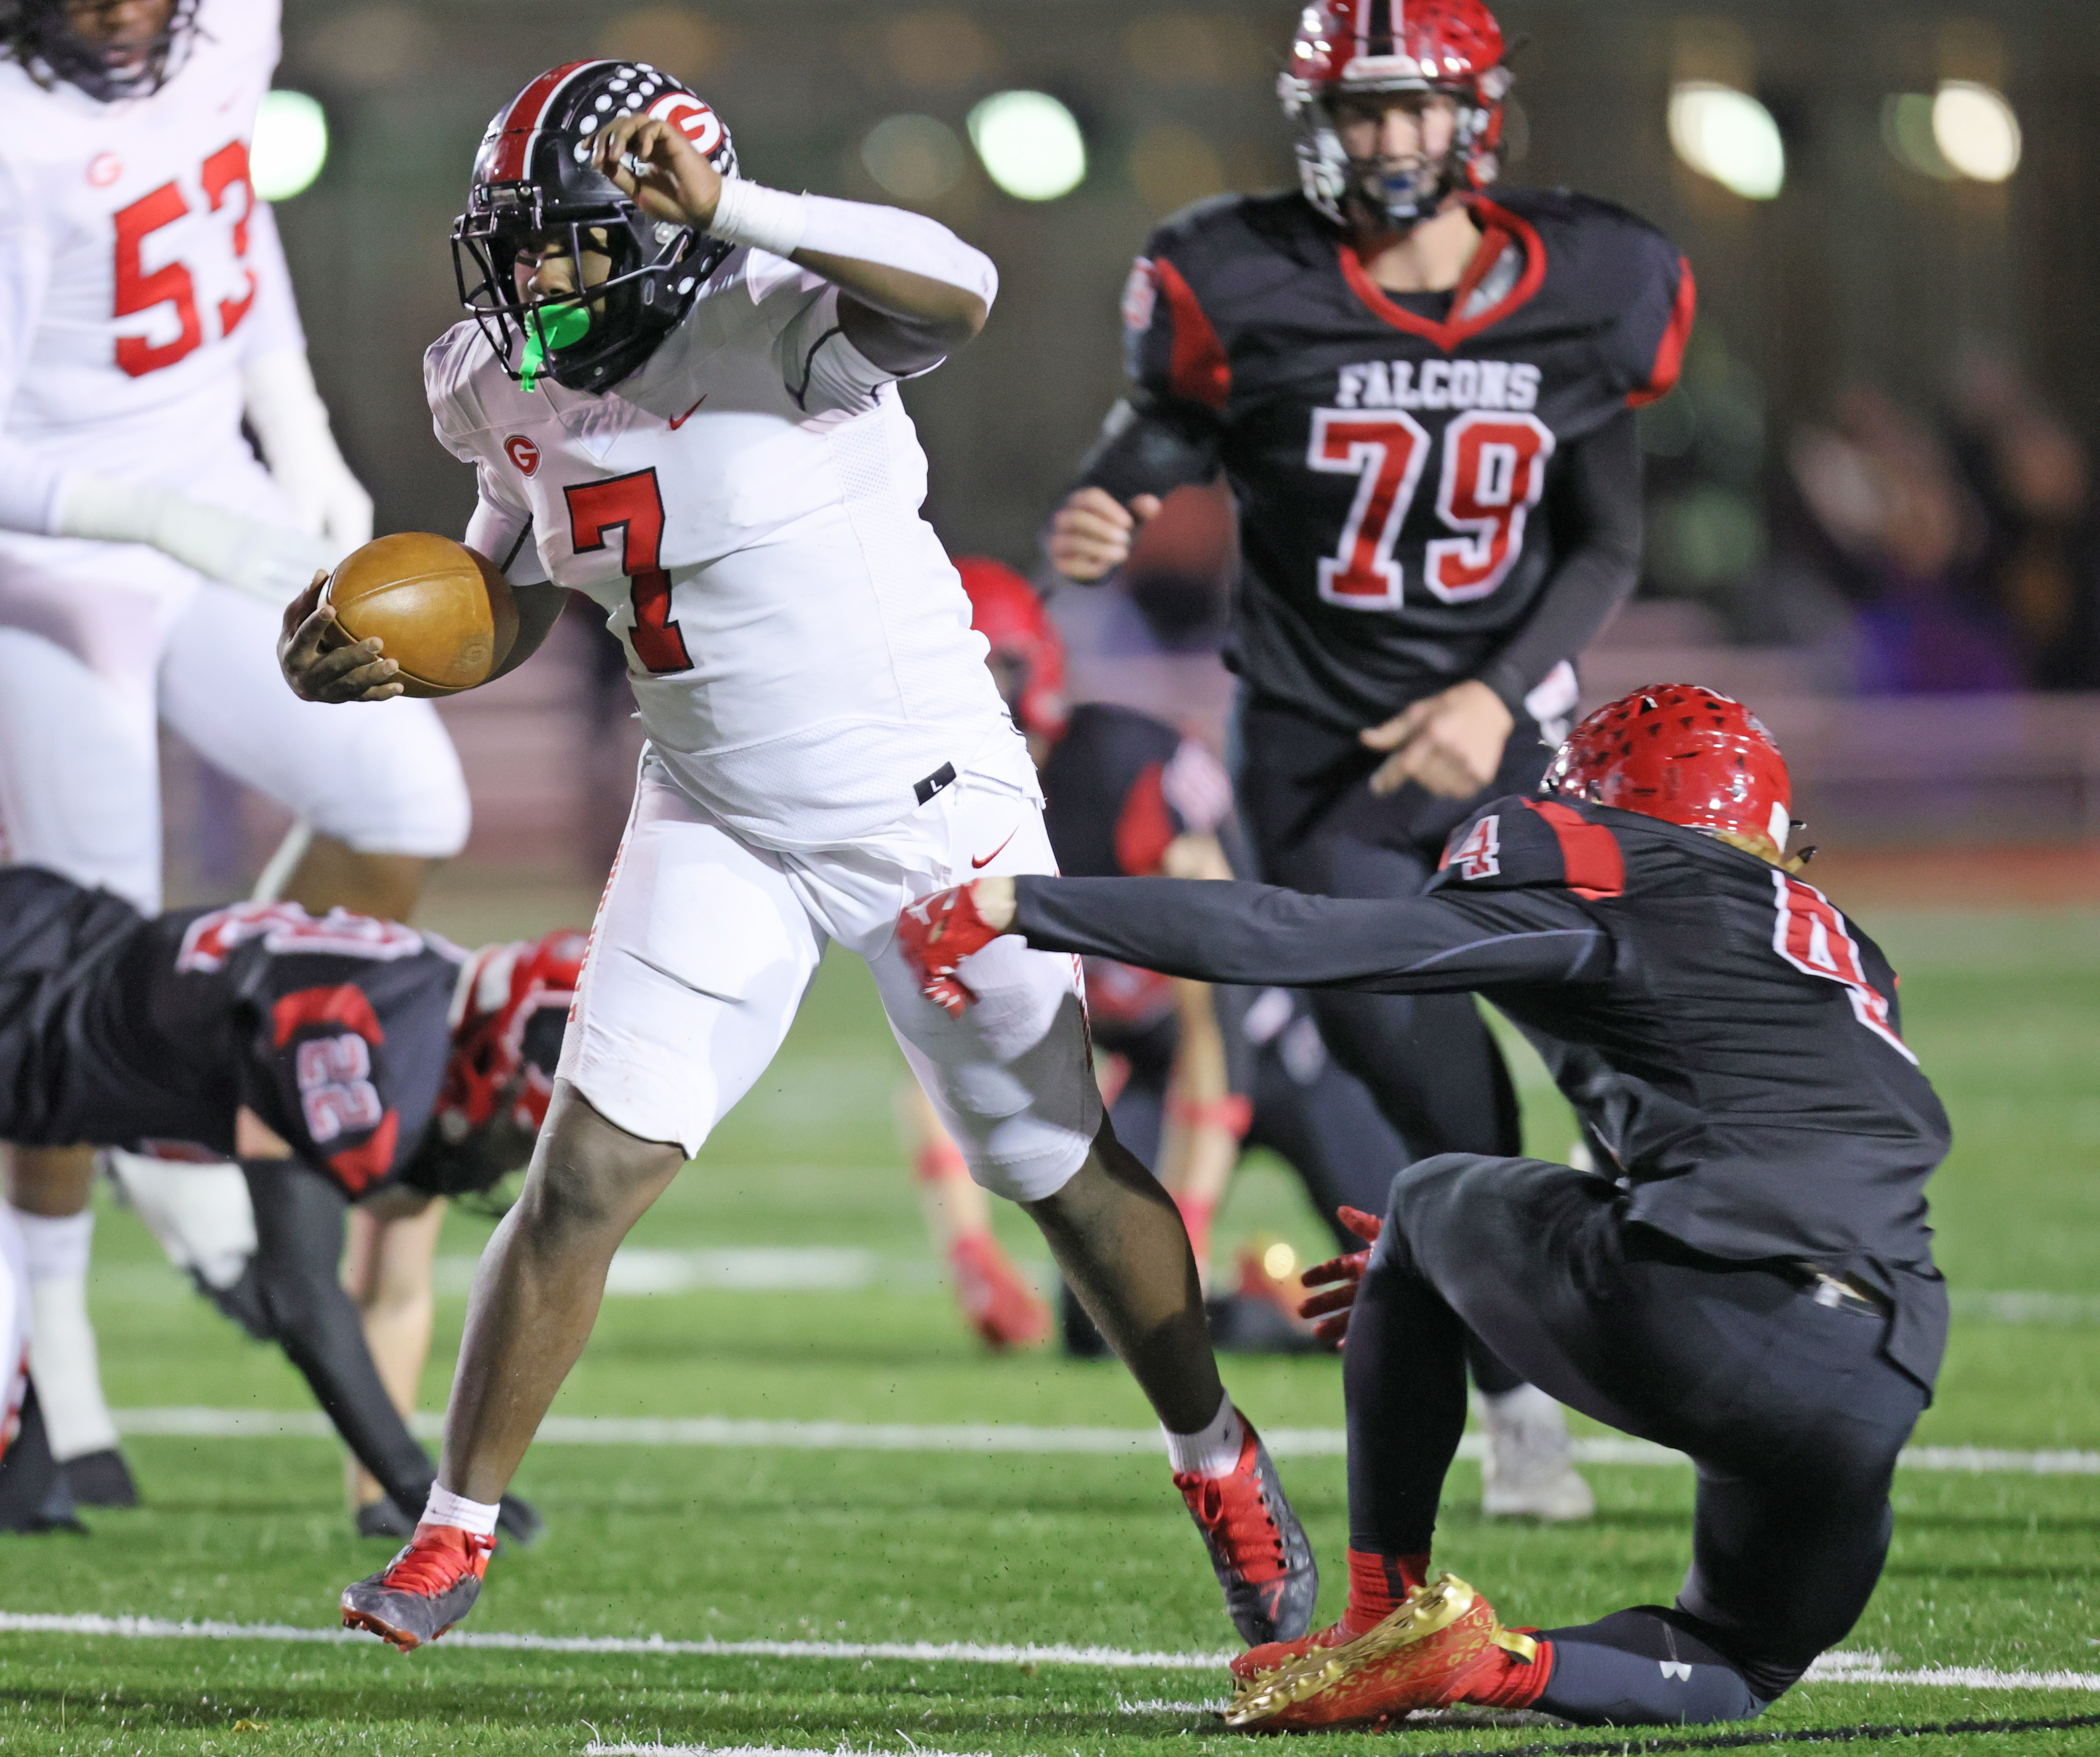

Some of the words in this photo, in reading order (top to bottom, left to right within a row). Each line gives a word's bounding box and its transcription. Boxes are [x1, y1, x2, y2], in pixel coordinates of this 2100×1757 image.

[646, 92, 723, 156] G
[113, 139, 257, 378] 53
[1335, 358, 1543, 410] FALCONS
[505, 436, 540, 476] G
[1307, 408, 1556, 610] 79
[563, 466, 695, 673] 7
[930, 780, 943, 792] L
[1448, 815, 1500, 880] 4
[296, 1033, 383, 1143] 22
